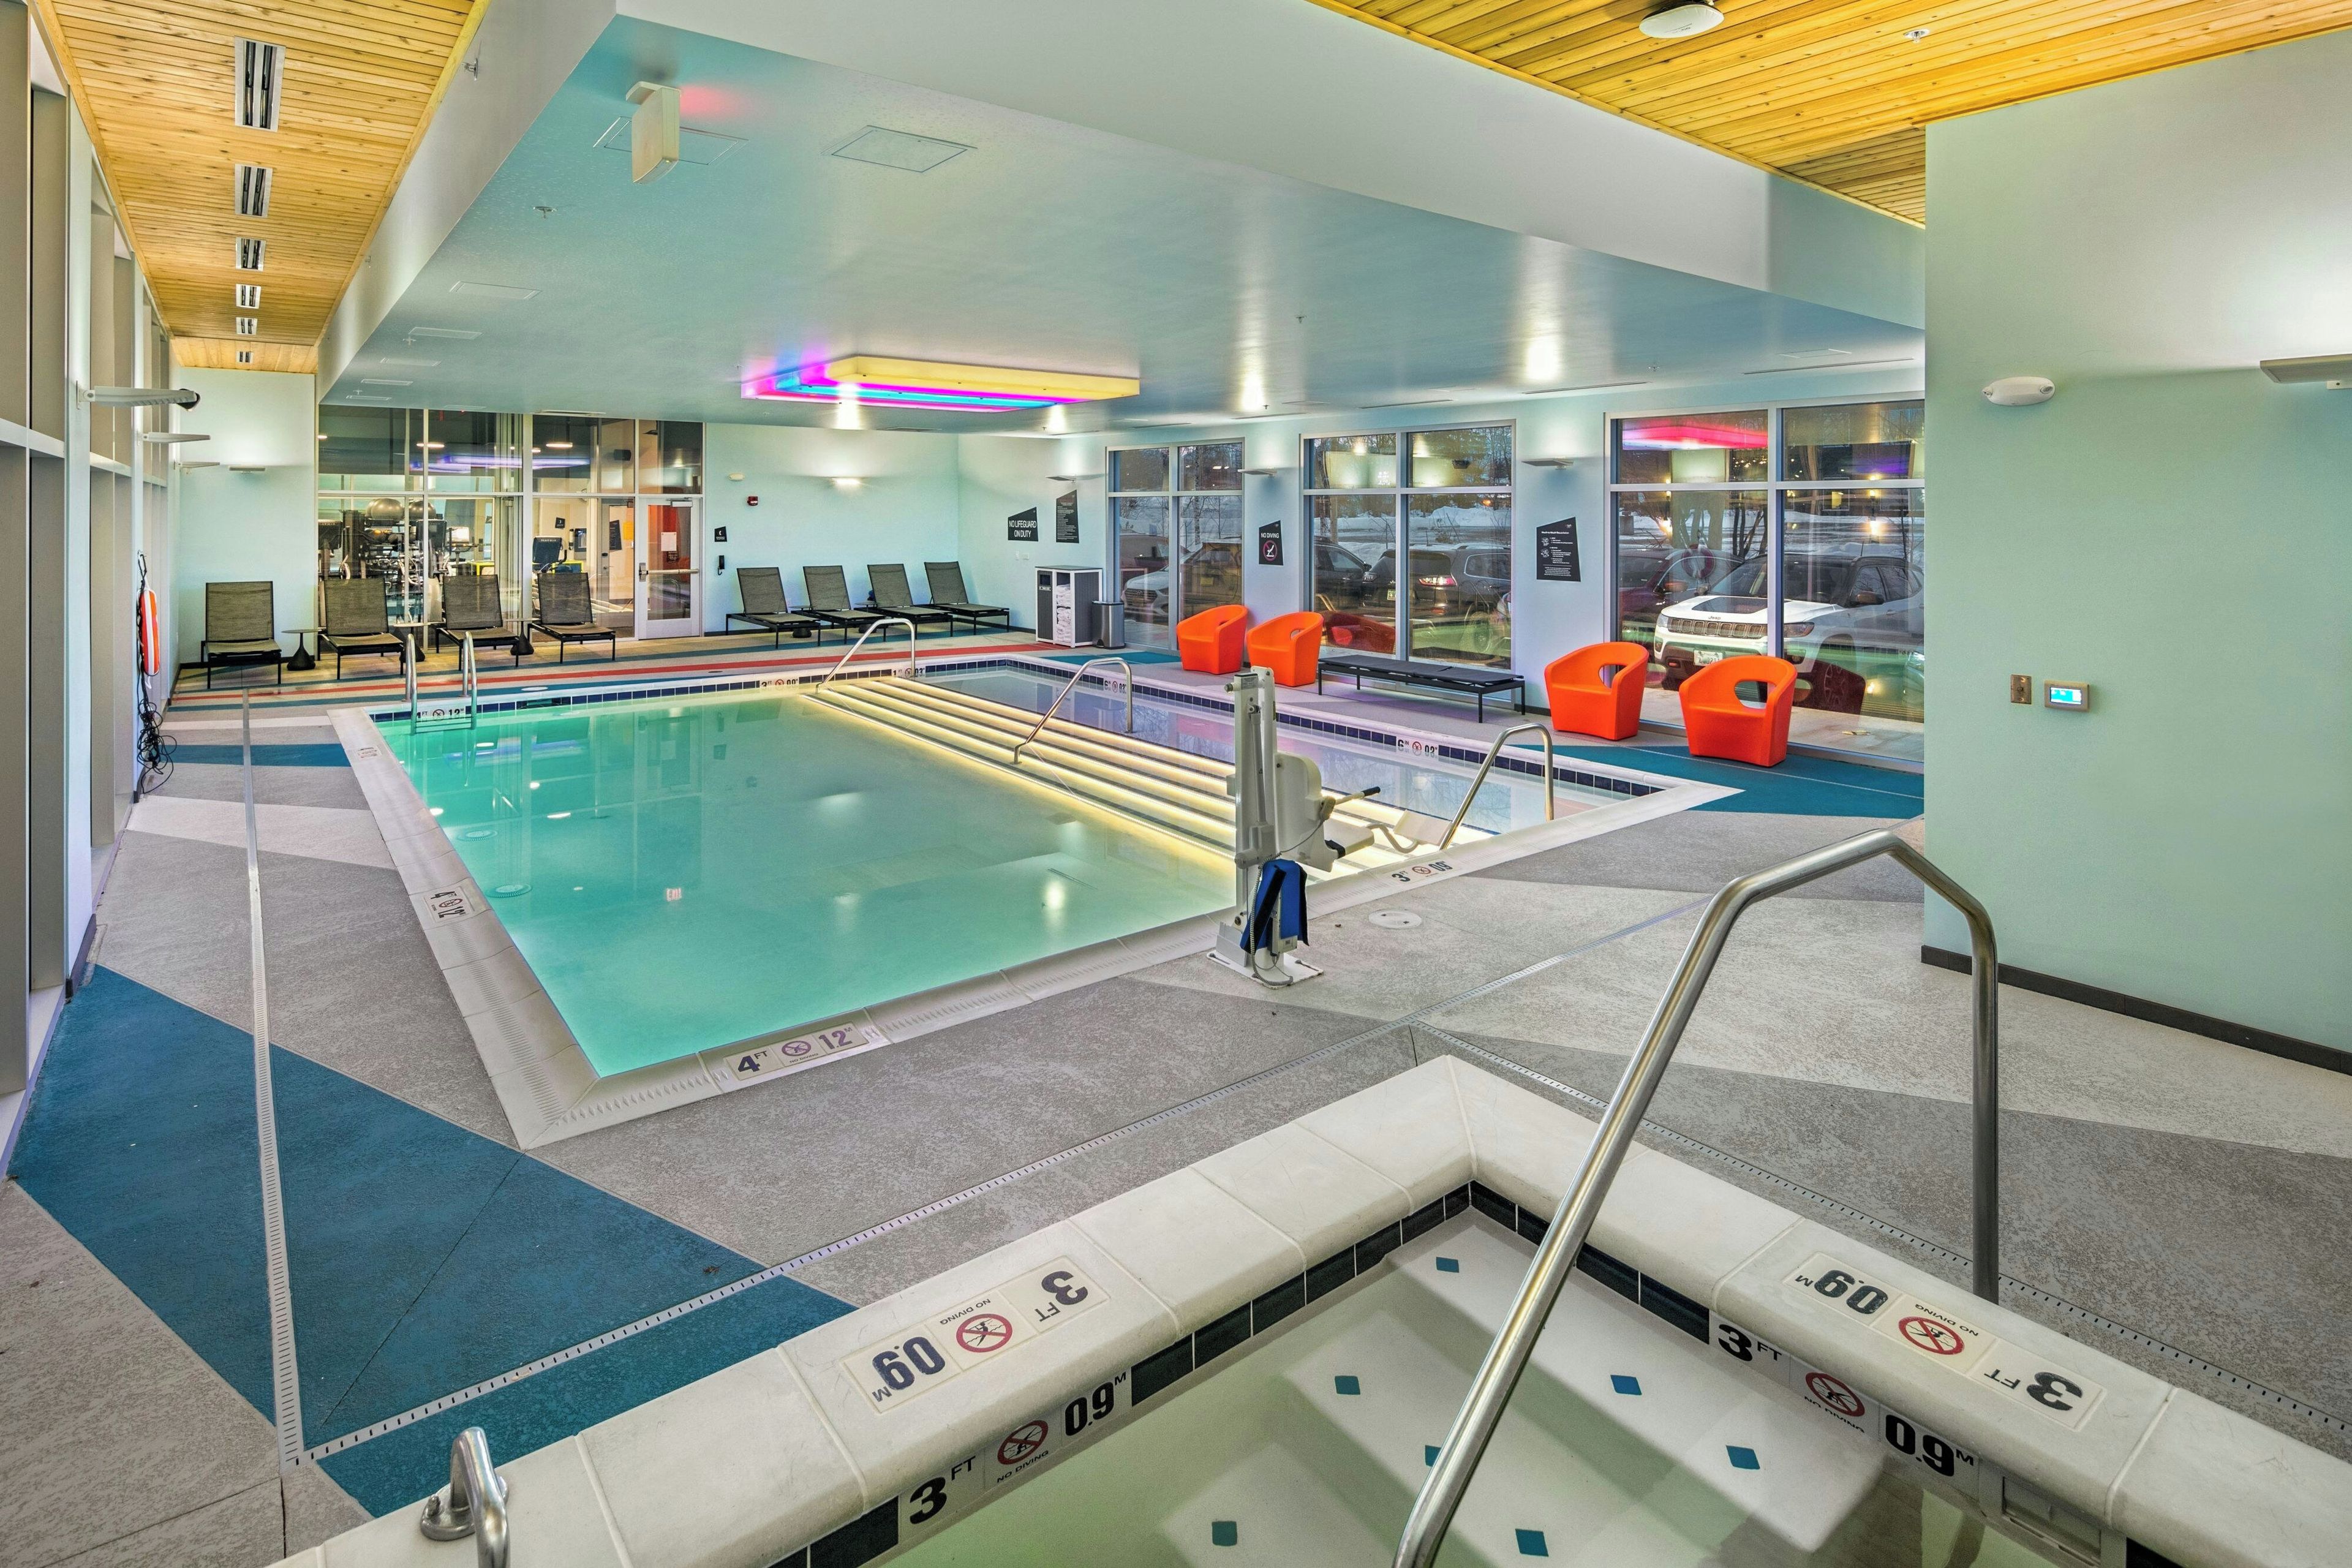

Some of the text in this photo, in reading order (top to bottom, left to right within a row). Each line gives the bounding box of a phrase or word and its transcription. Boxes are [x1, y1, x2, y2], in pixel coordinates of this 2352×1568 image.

[1392, 873, 1411, 882] 3
[737, 1055, 761, 1072] 4
[753, 1050, 768, 1060] FT
[1041, 1270, 1088, 1305] 3
[975, 1298, 991, 1308] NO
[1035, 1302, 1060, 1322] FT
[940, 1306, 974, 1325] DIVING
[1915, 1303, 1956, 1325] DIVING
[1959, 1325, 1979, 1336] NO
[1718, 1324, 1753, 1362] 3
[1757, 1341, 1782, 1361] FT
[1984, 1368, 2021, 1389] FT
[2026, 1371, 2084, 1411] 3
[910, 1477, 948, 1525] 3
[951, 1455, 976, 1481] FT
[997, 1471, 1012, 1483] NO
[1015, 1449, 1049, 1472] DIVING
